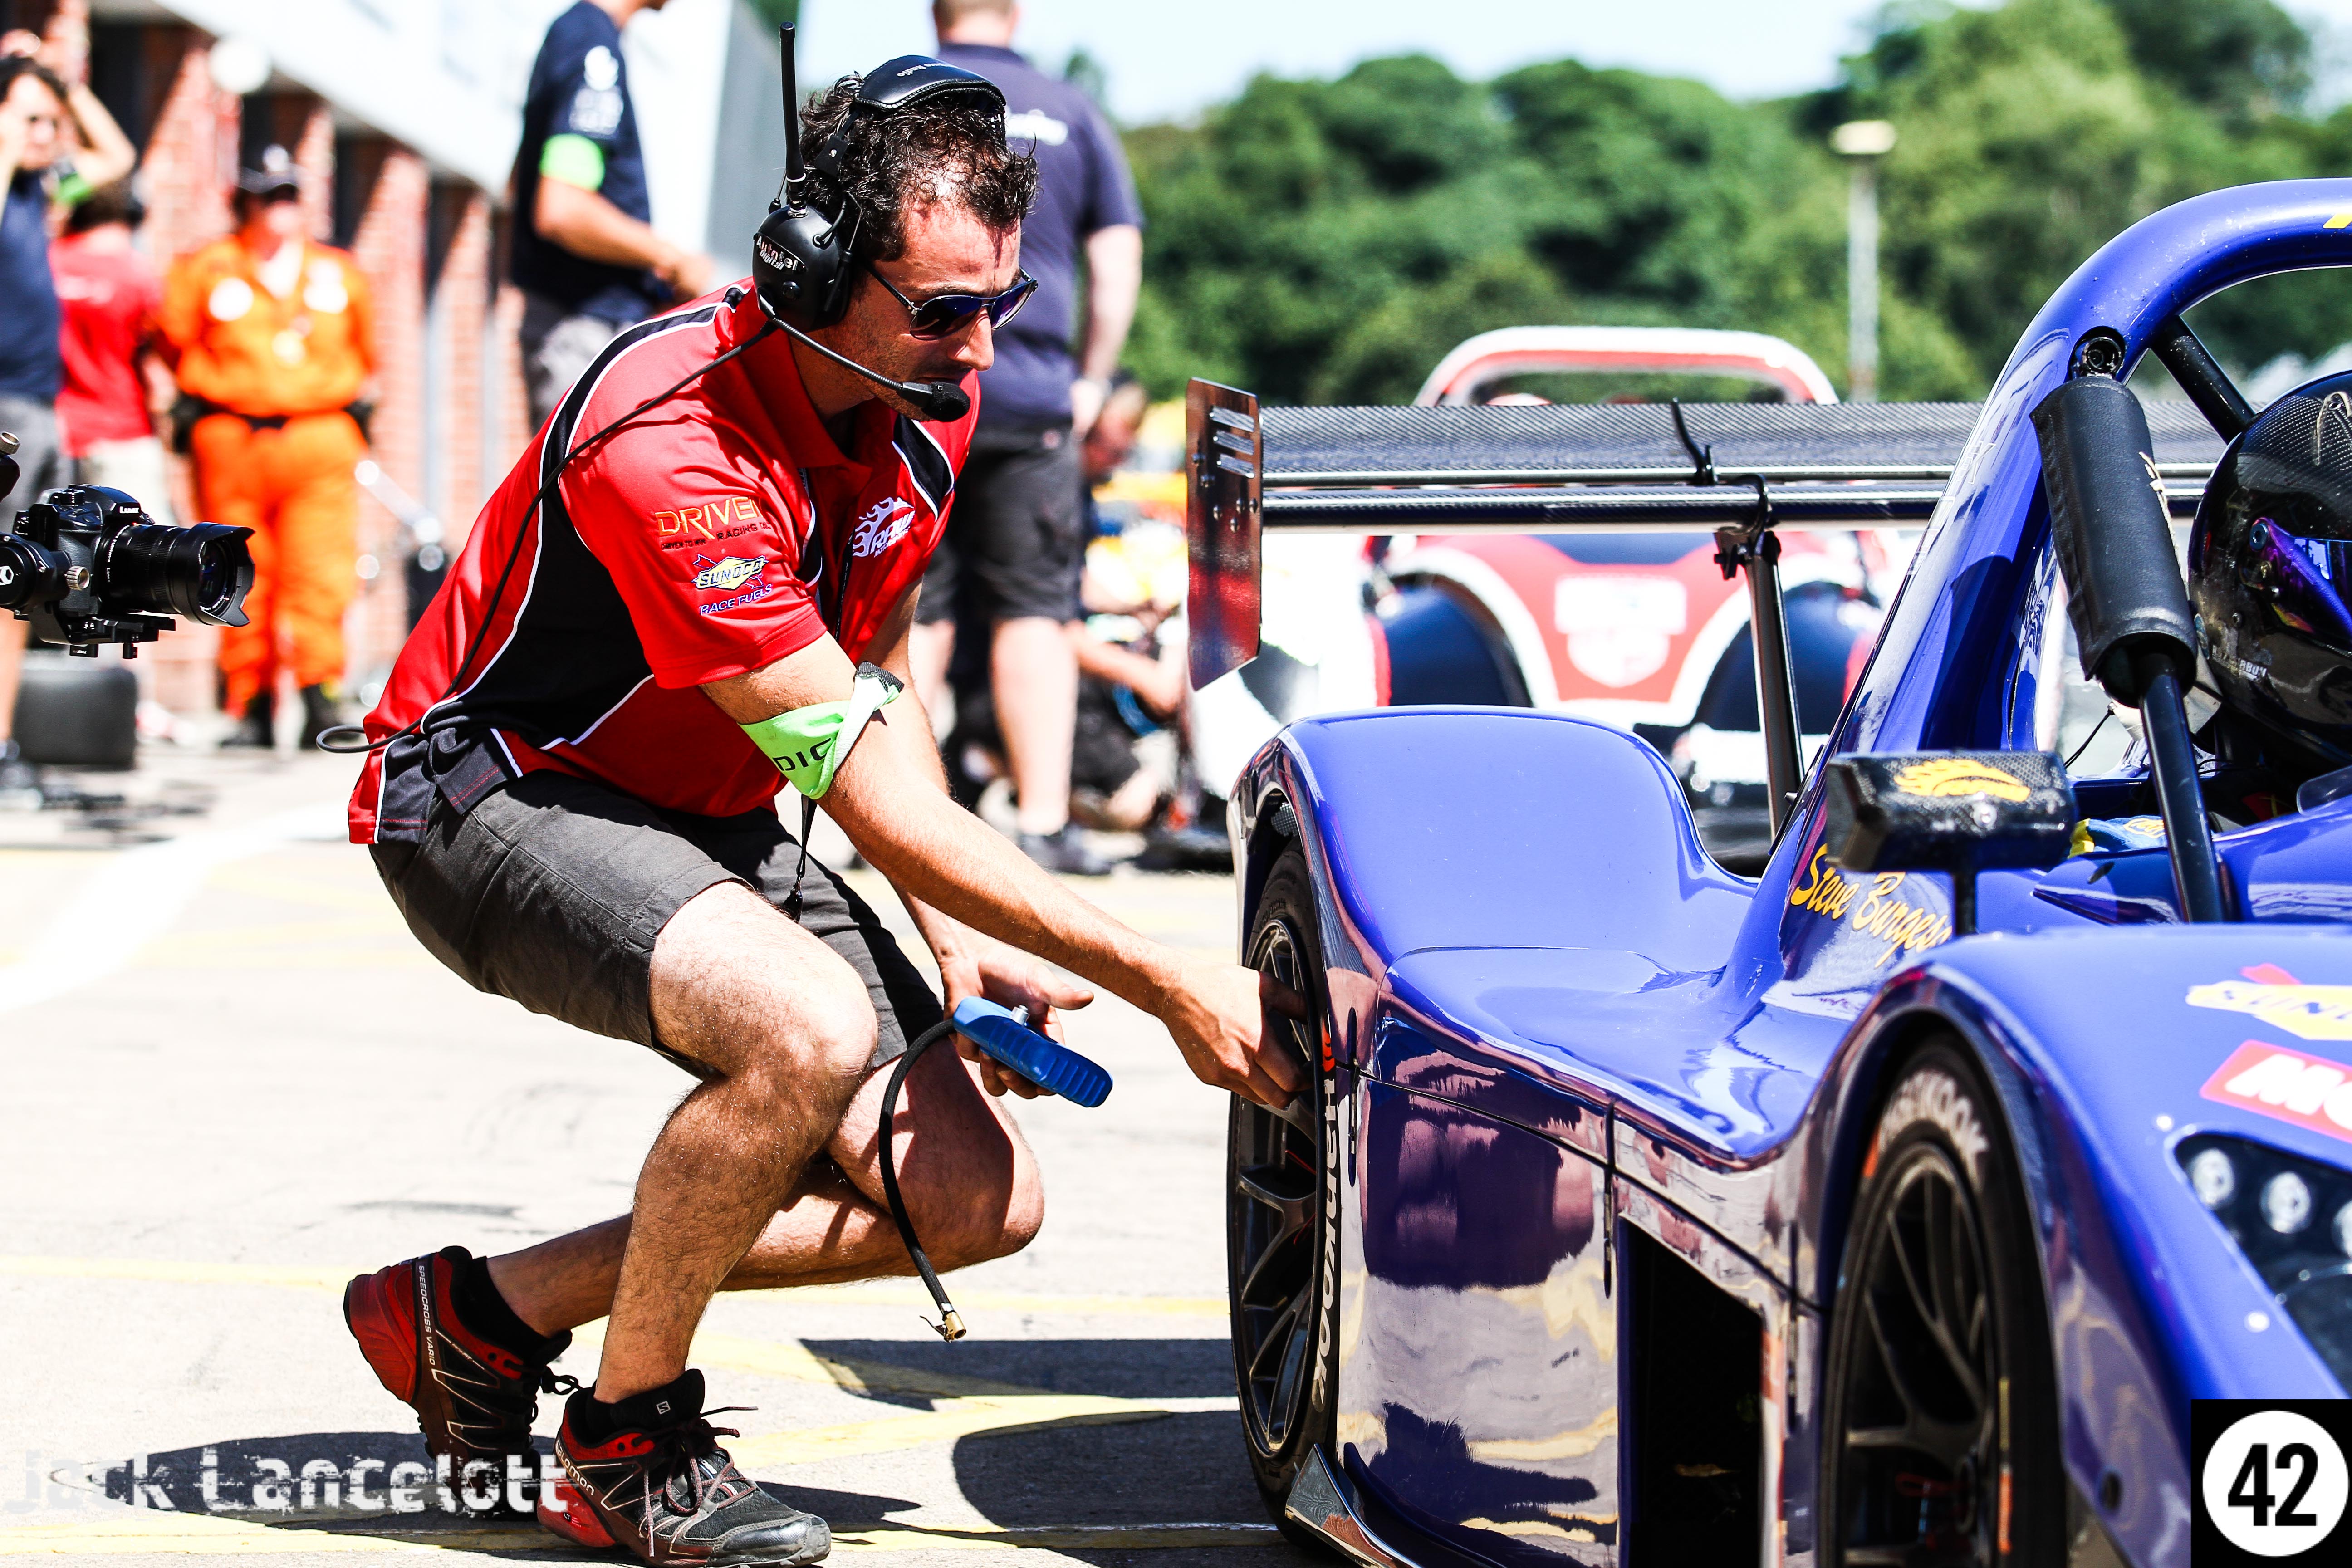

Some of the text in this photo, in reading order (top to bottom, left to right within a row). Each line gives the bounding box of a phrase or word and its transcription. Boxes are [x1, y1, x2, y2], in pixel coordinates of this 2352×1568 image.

[756, 236, 798, 271] Autotel
[760, 249, 785, 270] Digital
[716, 524, 757, 541] RACING
[700, 559, 762, 586] SUNOCO
[699, 583, 773, 616] RACE FUELS
[1791, 843, 1860, 920] Steve
[1312, 1078, 1337, 1412] Hankook
[418, 1265, 436, 1366] SPEEDCROSS VARIO
